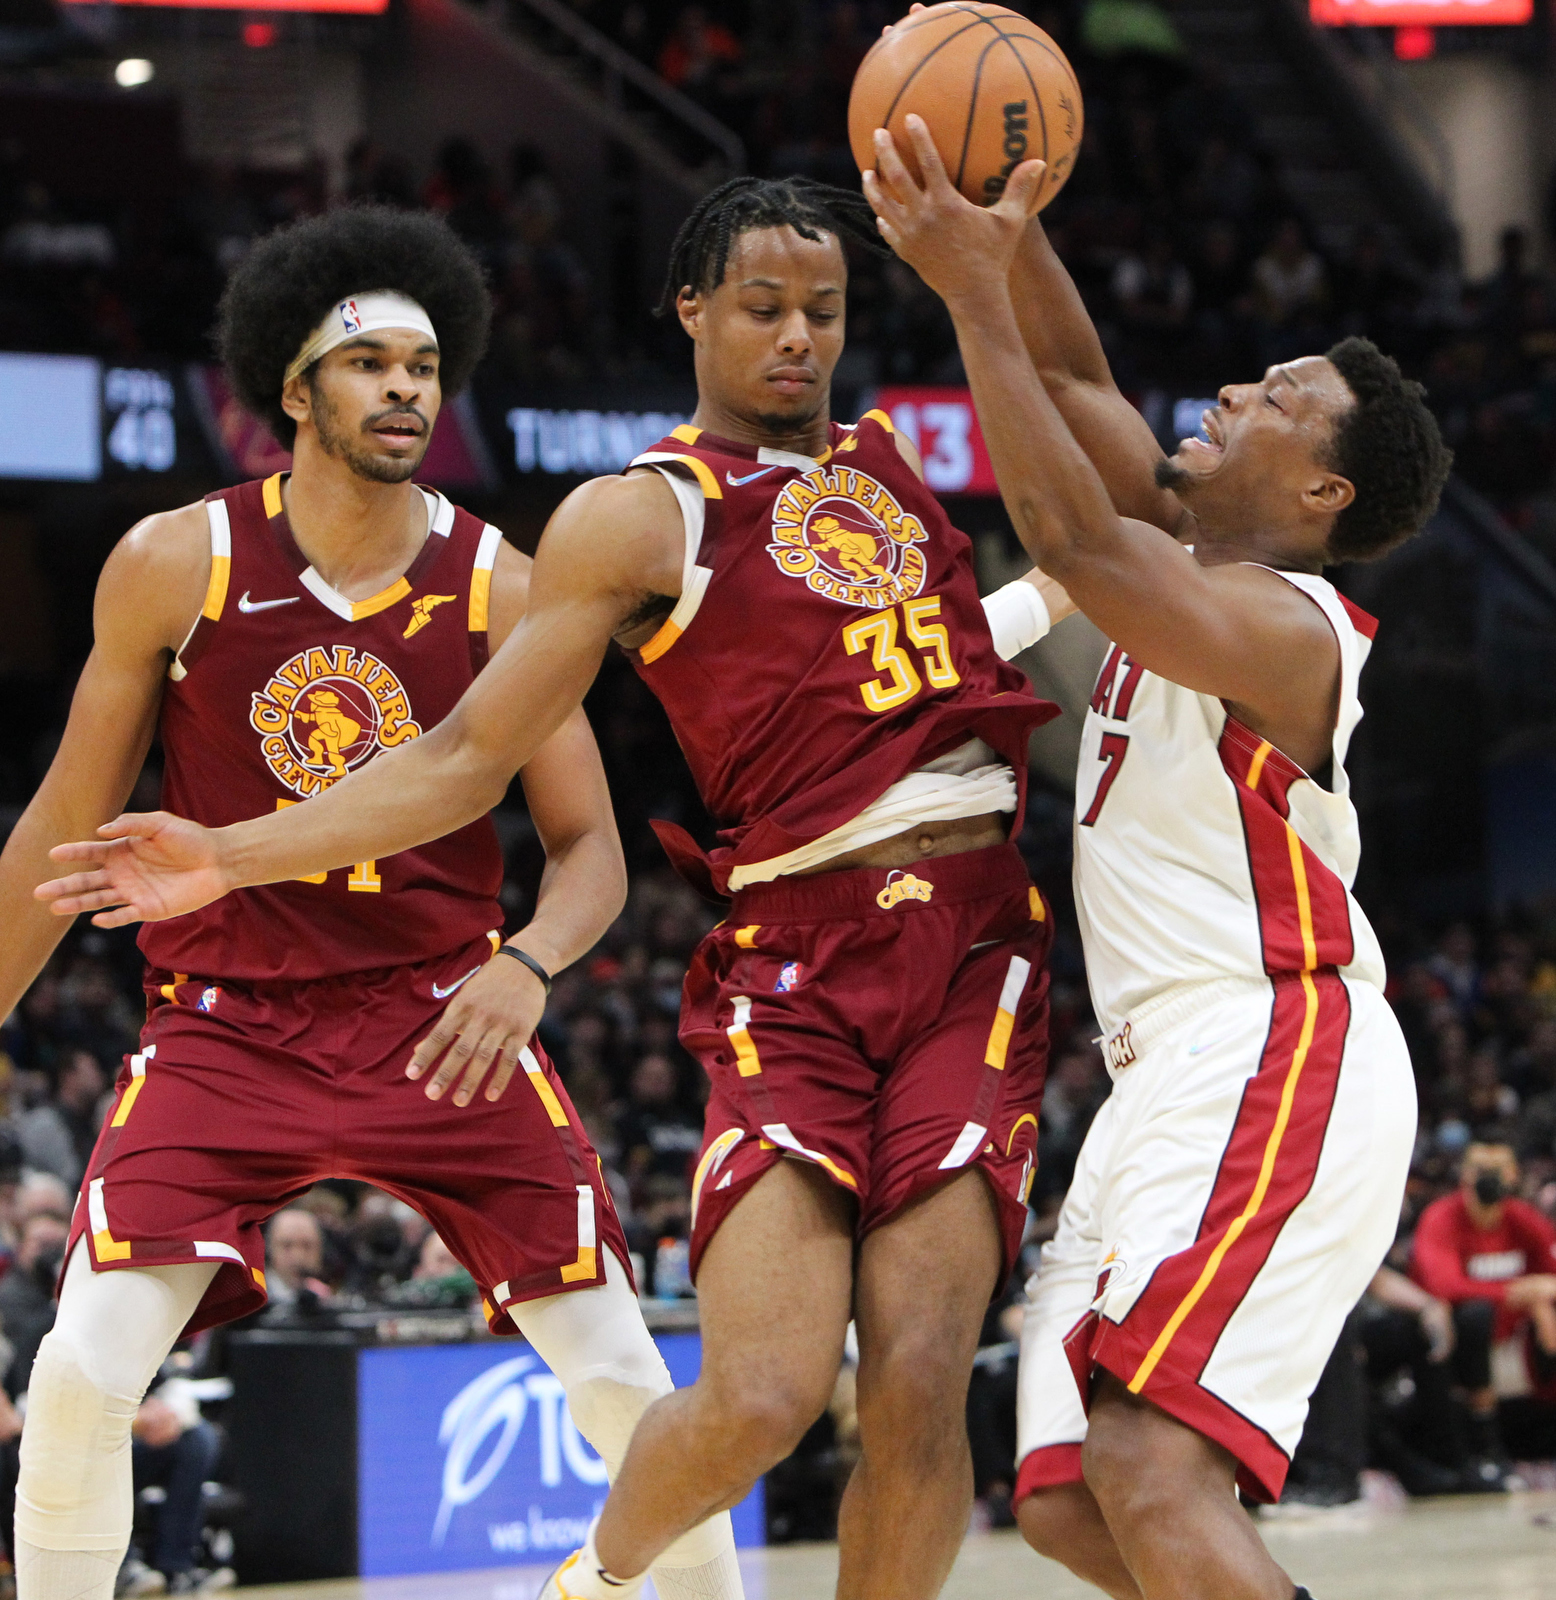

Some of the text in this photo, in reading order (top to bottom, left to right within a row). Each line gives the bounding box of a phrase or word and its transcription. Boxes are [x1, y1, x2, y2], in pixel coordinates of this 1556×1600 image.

[108, 405, 176, 471] 40
[765, 466, 928, 577] CAVALIERS
[806, 545, 926, 608] CLEVELAND
[250, 645, 422, 748] CAVALIERS
[842, 594, 961, 712] 35
[1079, 730, 1130, 828] 7
[876, 871, 934, 910] CAVS
